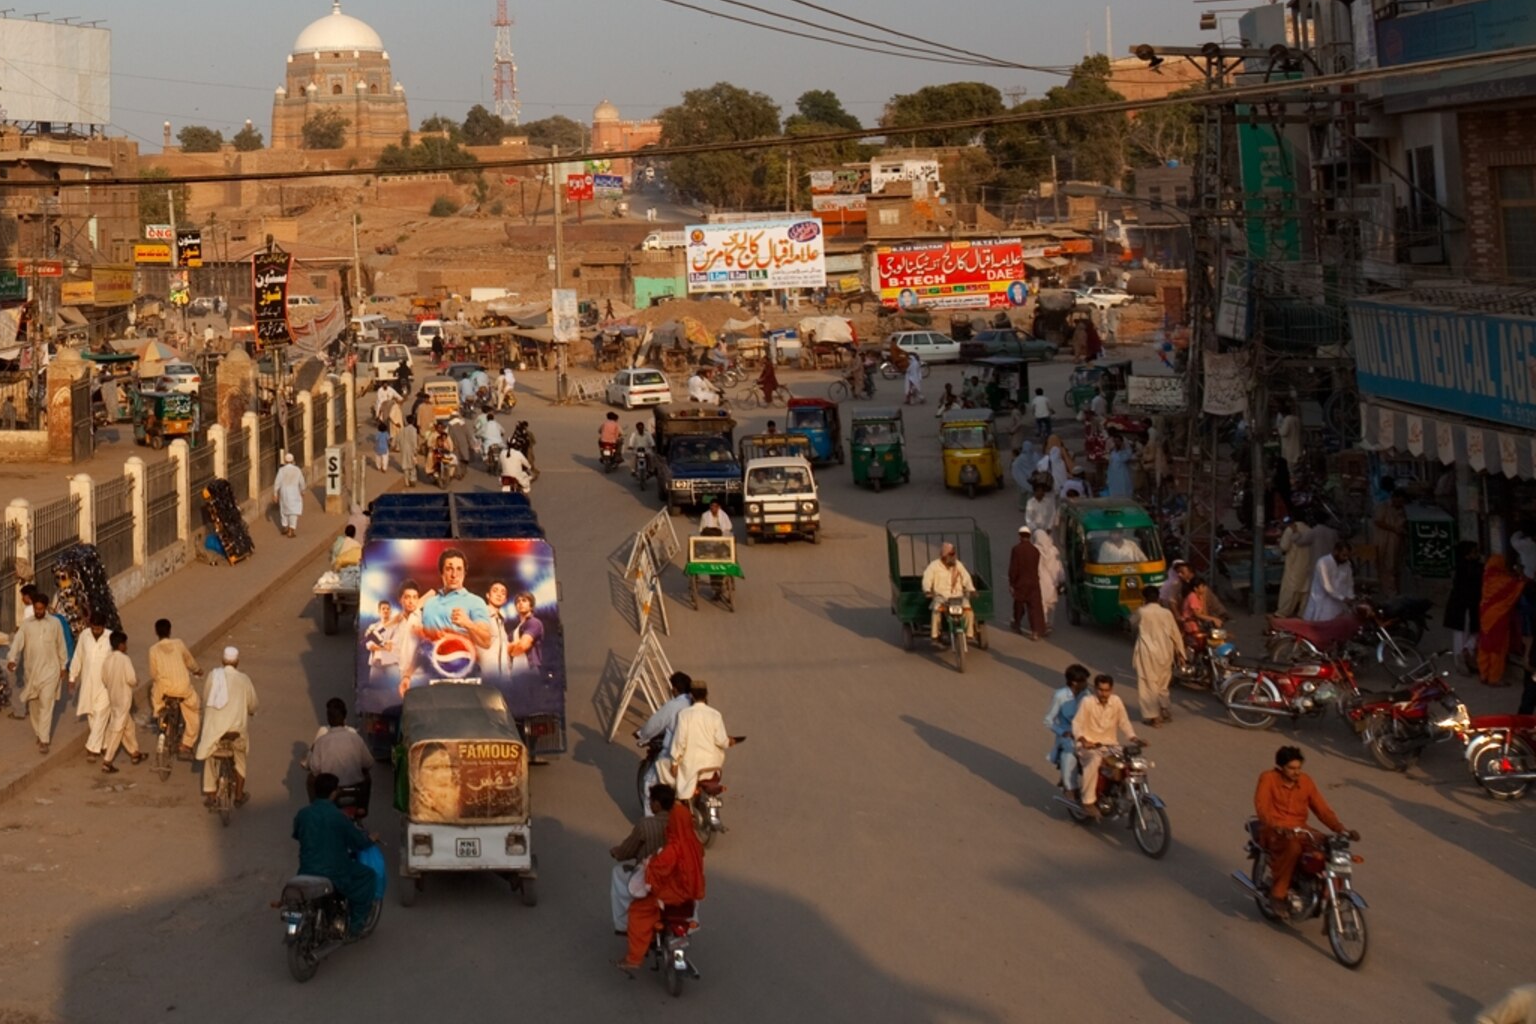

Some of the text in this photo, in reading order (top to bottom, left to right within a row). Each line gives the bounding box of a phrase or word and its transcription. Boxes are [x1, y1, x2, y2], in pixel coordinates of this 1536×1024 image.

[1348, 306, 1416, 383] MULTAN
[1414, 315, 1497, 398] MEDICAL
[458, 744, 520, 759] FAMOUS
